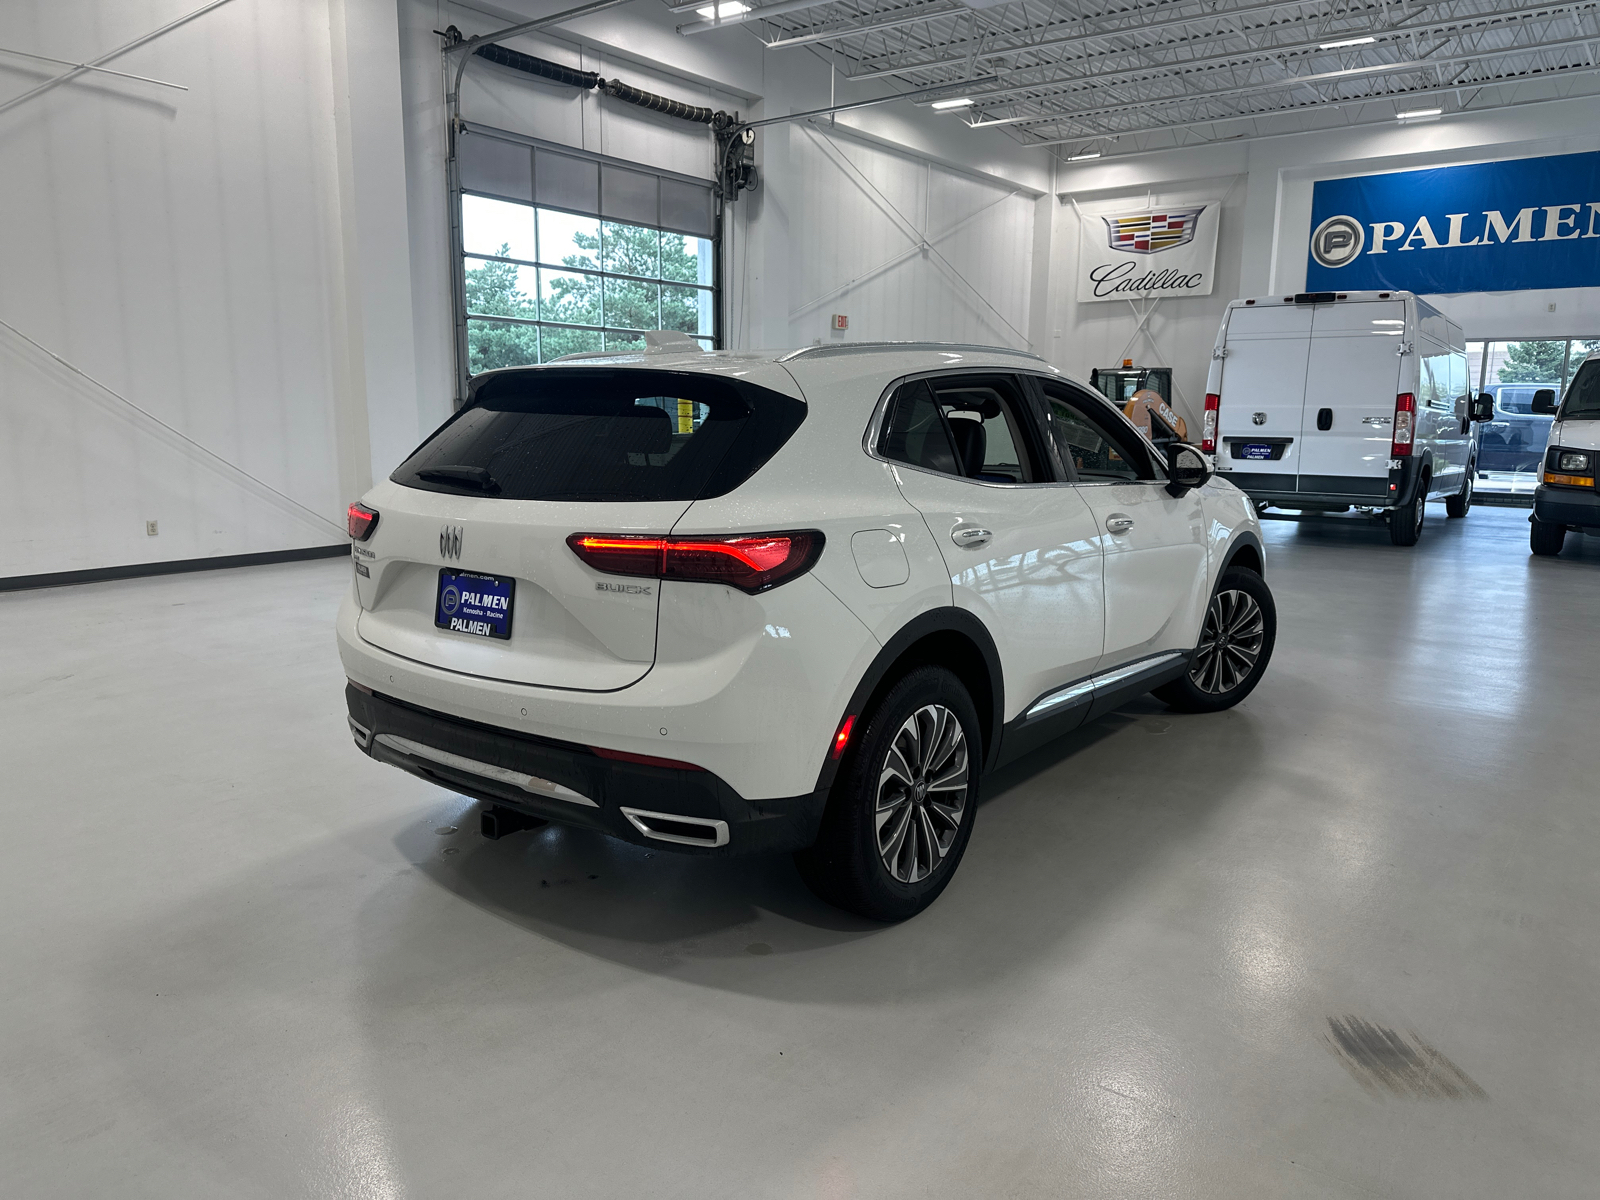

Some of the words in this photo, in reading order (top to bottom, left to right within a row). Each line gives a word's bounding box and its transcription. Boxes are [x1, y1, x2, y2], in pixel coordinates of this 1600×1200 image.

[1089, 260, 1203, 297] Cadillac
[1158, 402, 1178, 428] CASE
[595, 581, 652, 596] BUICK
[461, 592, 508, 610] PALMEN
[463, 607, 483, 616] Kenosha
[486, 610, 504, 619] Racine
[450, 618, 490, 636] PALMEN
